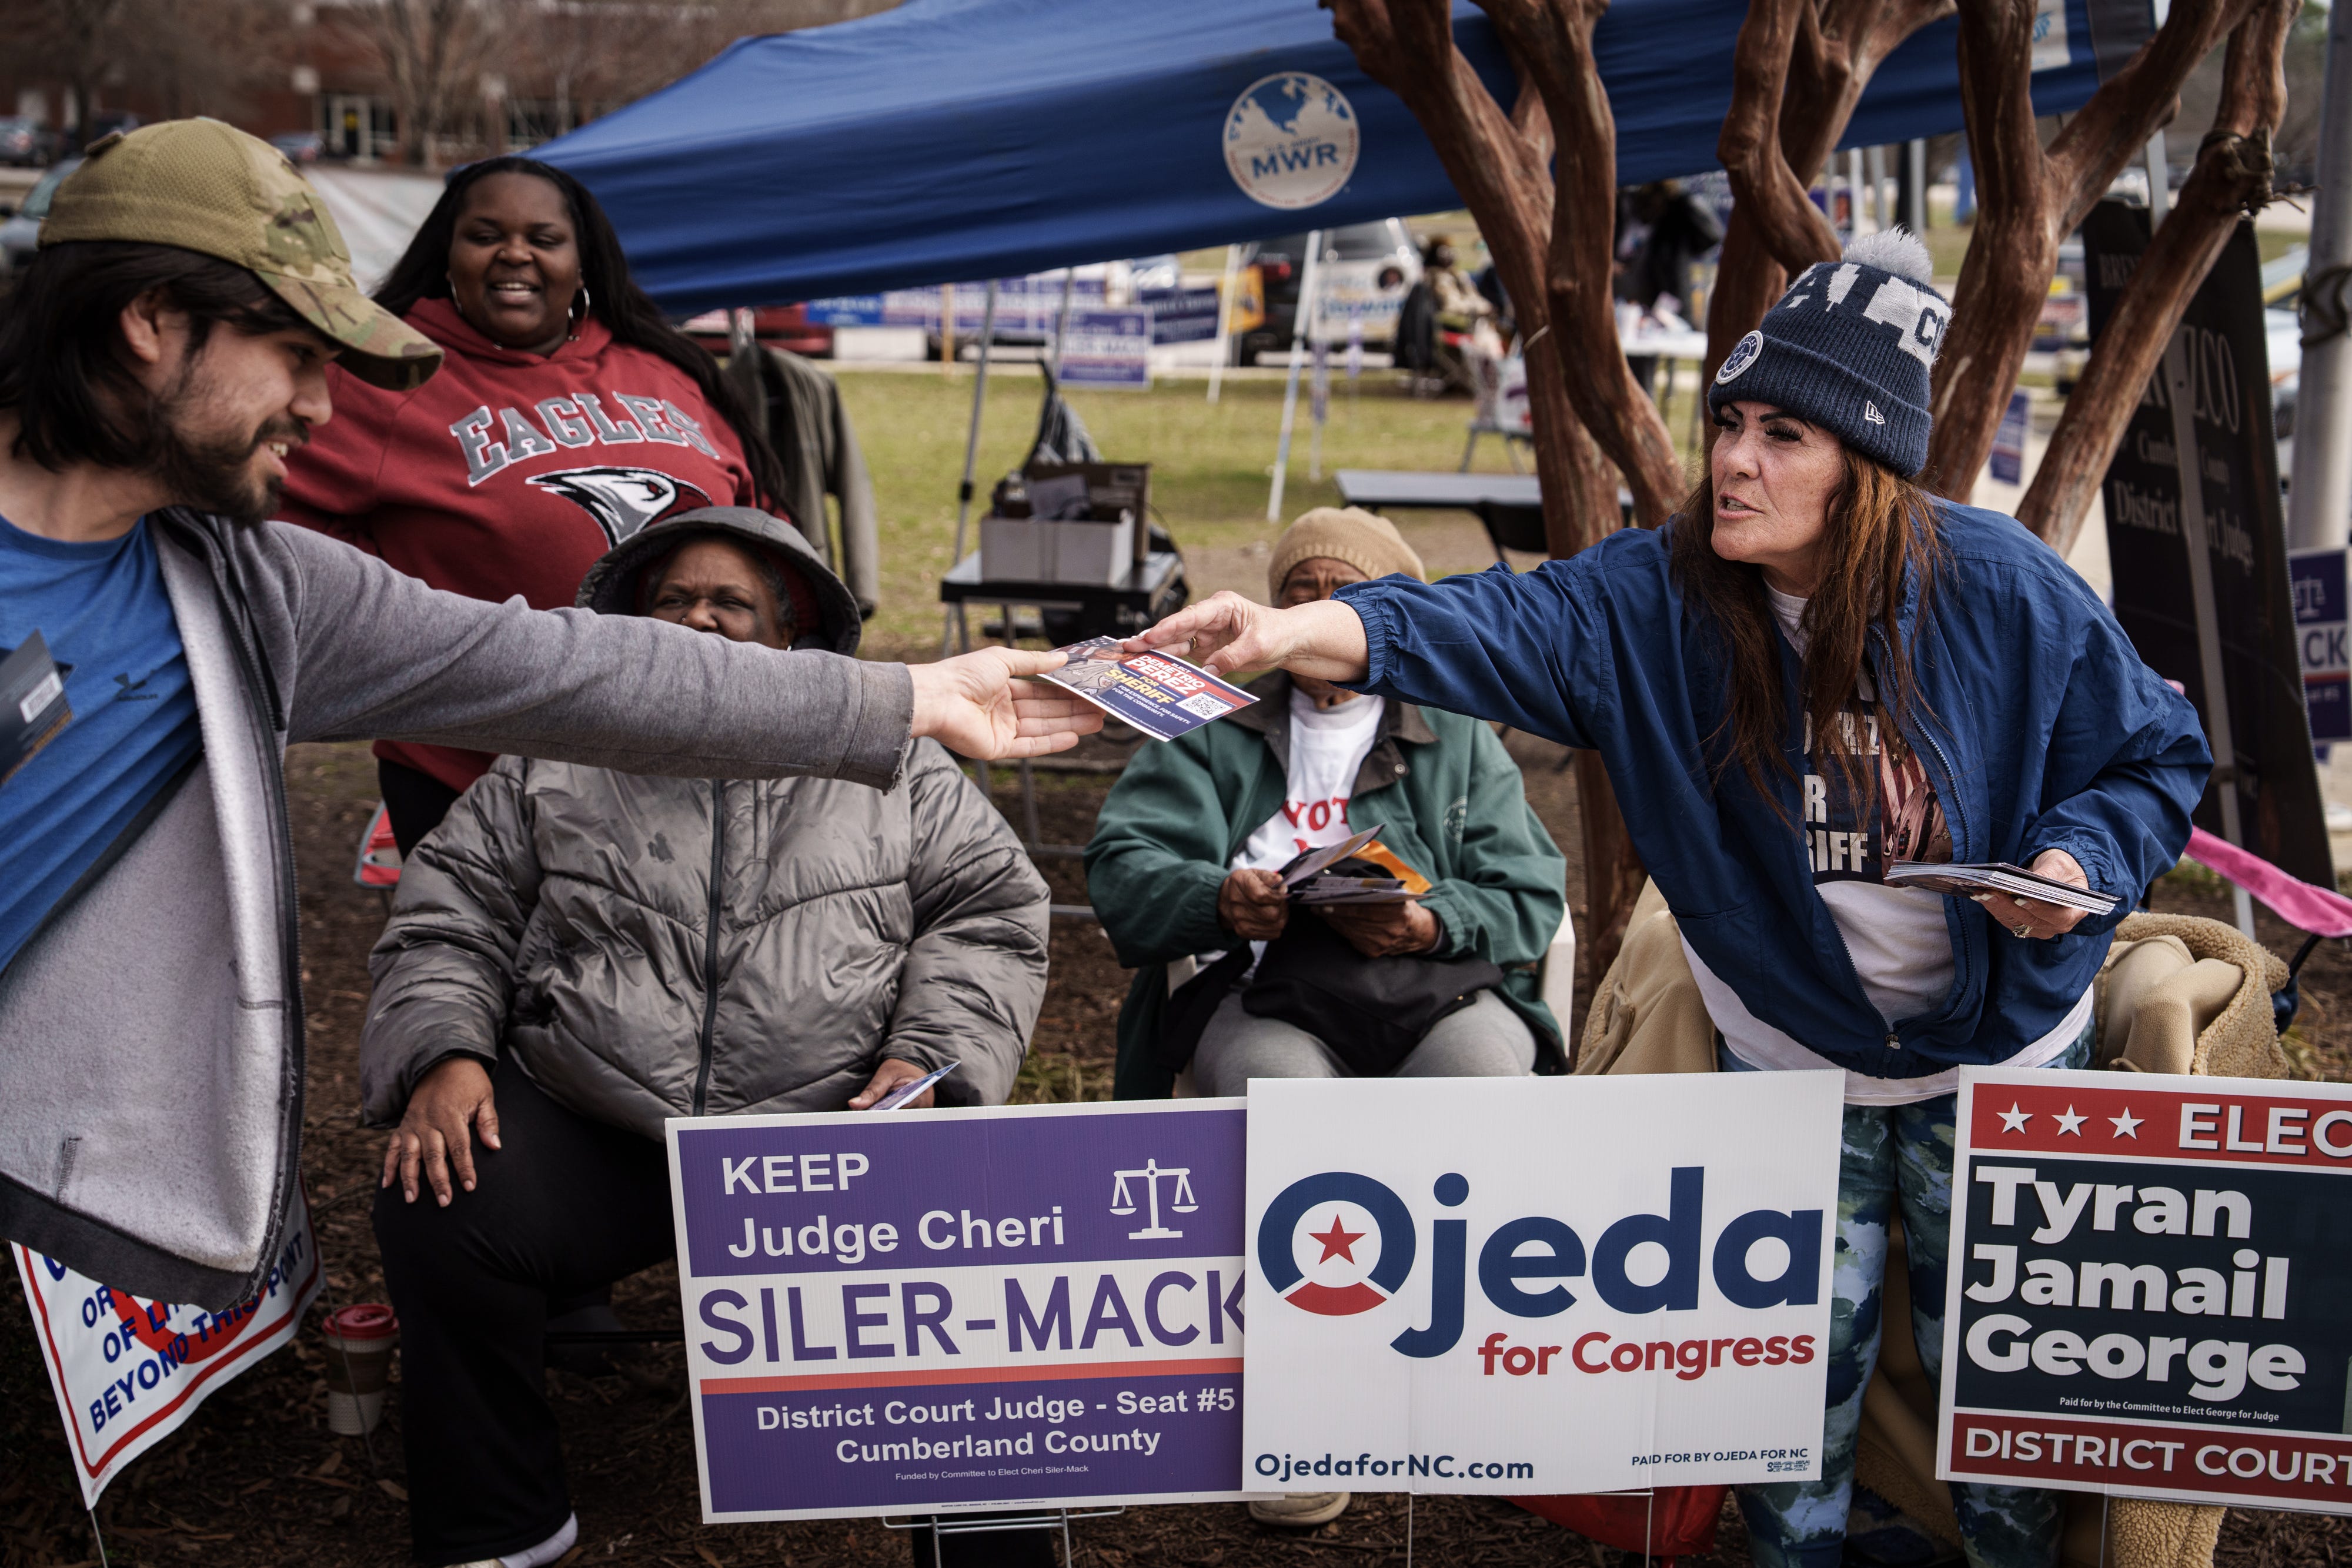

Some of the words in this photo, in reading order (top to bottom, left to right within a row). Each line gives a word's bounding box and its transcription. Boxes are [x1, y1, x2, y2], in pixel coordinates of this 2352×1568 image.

[1252, 143, 1339, 179] MWR
[449, 390, 720, 487] EAGLES
[1104, 668, 1175, 704] SHERIFF
[1124, 658, 1198, 695] PEREZ
[1138, 655, 1205, 688] DEMETRIO
[1140, 676, 1160, 687] FOR
[1171, 663, 1192, 674] ELECT
[1118, 685, 1130, 693] FOR
[1281, 796, 1350, 831] VOT
[2179, 1103, 2352, 1156] ELEC
[723, 1154, 869, 1194] KEEP
[1976, 1166, 2251, 1243] Tyran
[729, 1215, 898, 1263] Judge
[918, 1206, 1064, 1249] Cheri
[1258, 1166, 1823, 1358] Ojeda
[1965, 1243, 2289, 1320] Jamail
[82, 1285, 116, 1329] OR
[699, 1270, 1245, 1366] SILER-MACK
[89, 1332, 189, 1434] BEYOND
[268, 1232, 305, 1298] POINT
[103, 1316, 138, 1363] OF
[1478, 1333, 1562, 1375] for
[1572, 1332, 1815, 1380] Congress
[1966, 1313, 2306, 1401] George
[757, 1403, 874, 1429] District
[885, 1399, 975, 1424] Court
[985, 1396, 1084, 1423] Judge
[1117, 1390, 1188, 1414] Seat
[1197, 1388, 1234, 1411] #5
[2060, 1398, 2078, 1406] Paid
[2080, 1399, 2093, 1407] for
[2094, 1399, 2104, 1409] by
[2107, 1400, 2121, 1409] the
[2123, 1402, 2170, 1412] Committee
[2183, 1406, 2204, 1415] Elect
[2206, 1407, 2237, 1419] George
[2239, 1410, 2251, 1418] for
[2253, 1411, 2279, 1422] Judge
[837, 1432, 1033, 1462] Cumberland
[1045, 1429, 1161, 1455] County
[1632, 1455, 1661, 1465] PAID
[1665, 1453, 1690, 1463] FOR
[1695, 1453, 1710, 1462] BY
[1714, 1451, 1757, 1461] OJEDA
[1761, 1450, 1786, 1459] FOR
[1790, 1449, 1808, 1457] NC
[1966, 1428, 2184, 1471] DISTRICT
[1045, 1465, 1088, 1473] Siler-Mack
[1255, 1453, 1533, 1482] OjedaforNC.com
